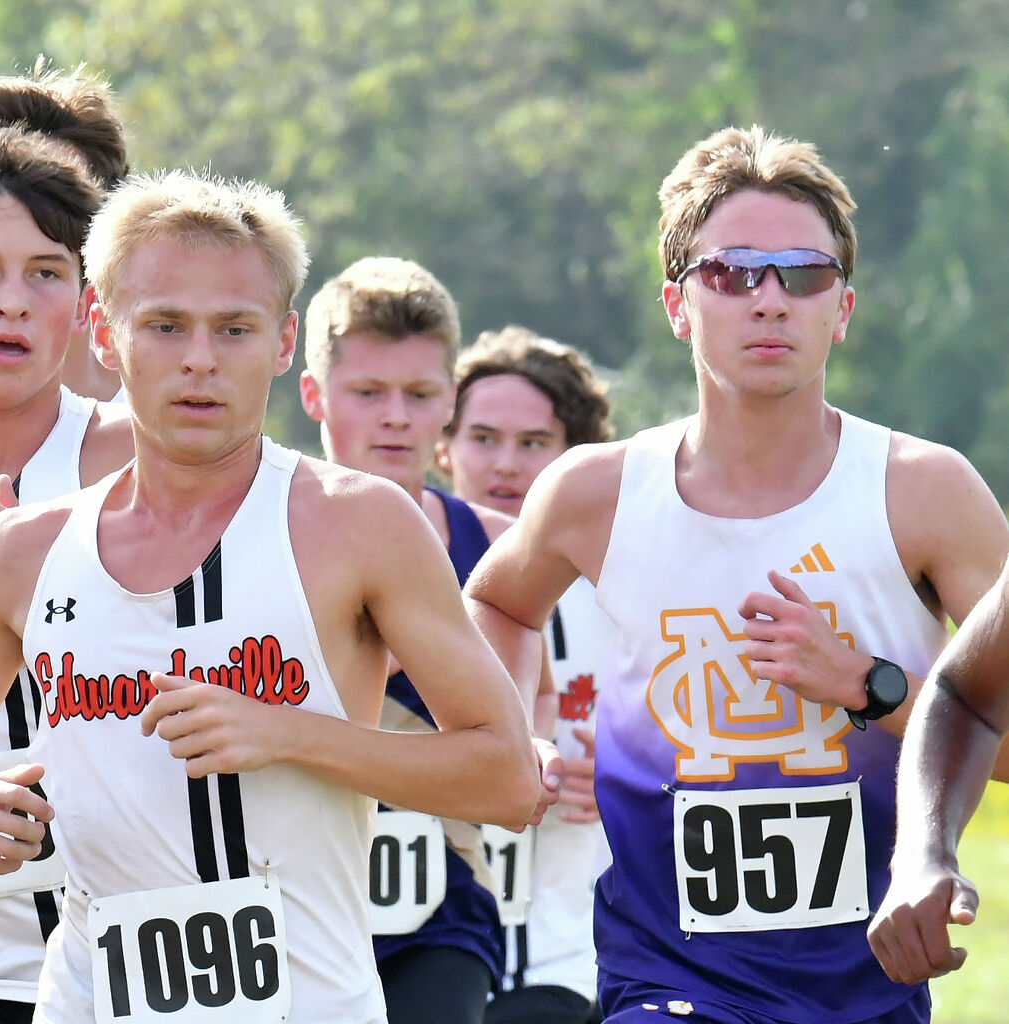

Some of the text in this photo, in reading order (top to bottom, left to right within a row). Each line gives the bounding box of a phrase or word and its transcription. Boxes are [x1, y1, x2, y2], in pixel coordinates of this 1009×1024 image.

[369, 835, 427, 906] 01
[683, 798, 853, 916] 957
[97, 905, 280, 1018] 1096
